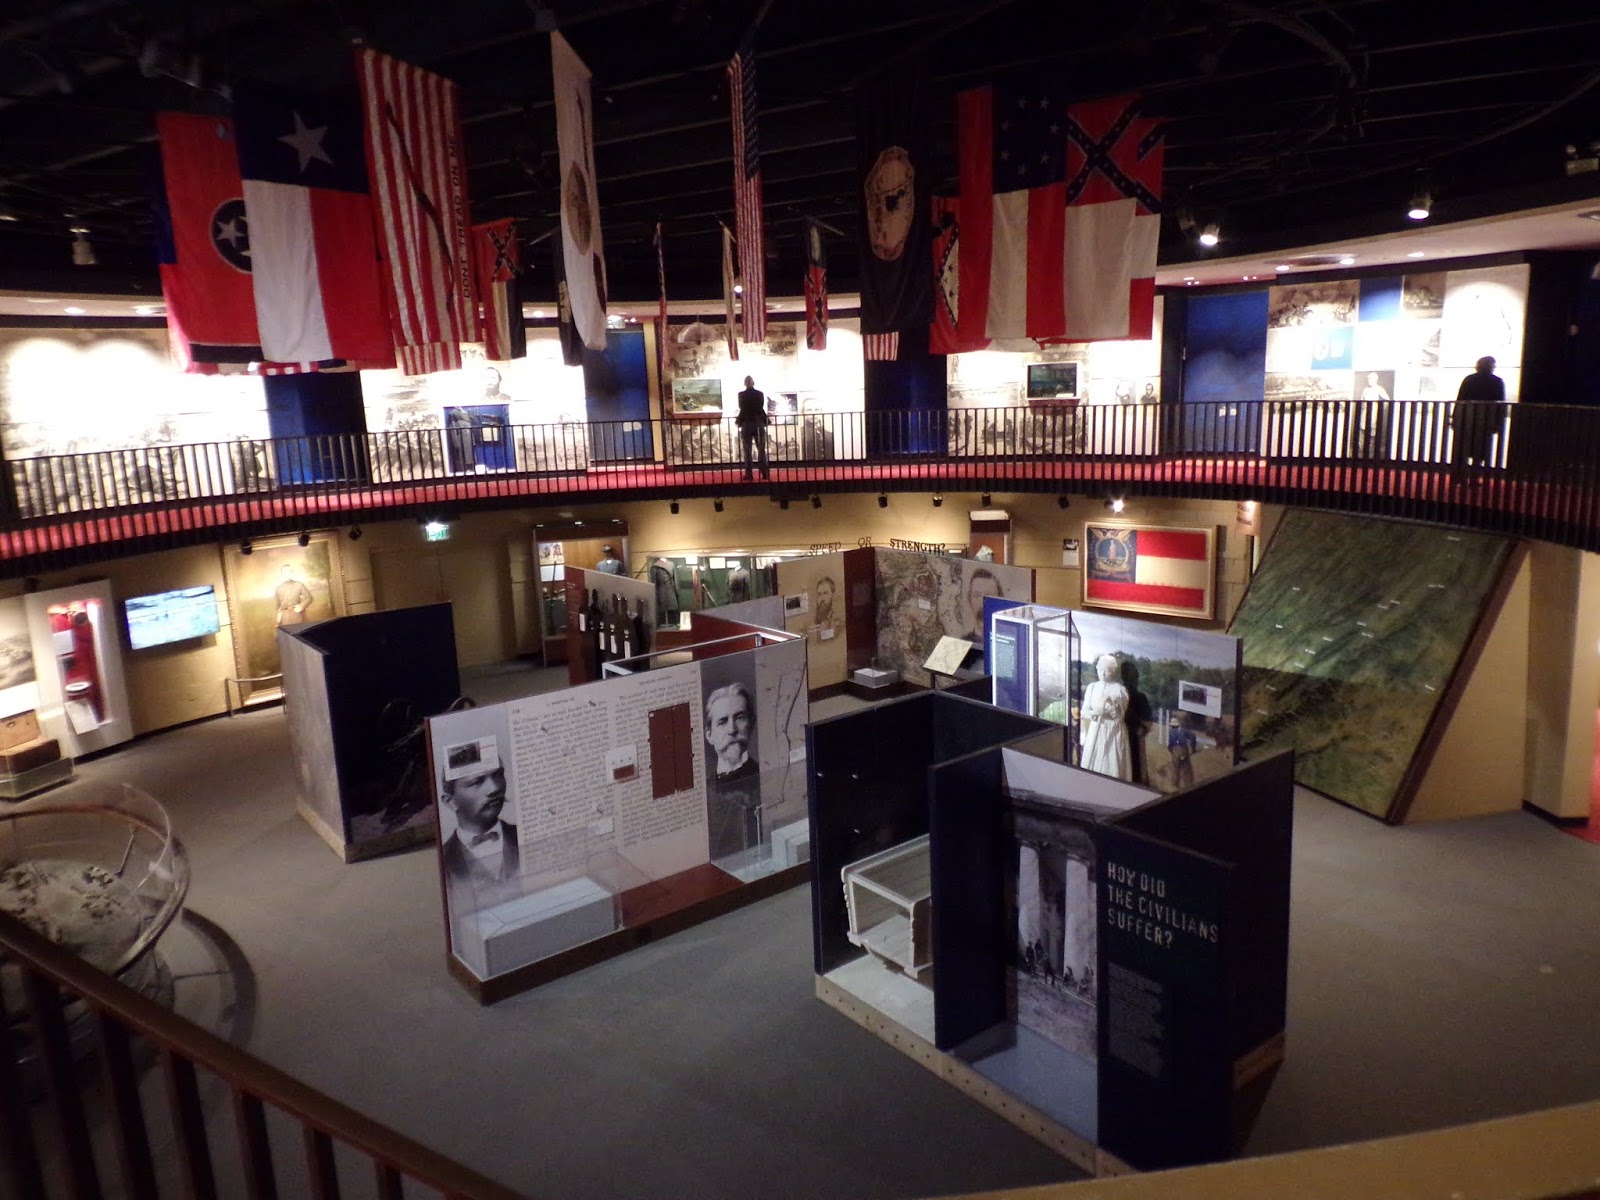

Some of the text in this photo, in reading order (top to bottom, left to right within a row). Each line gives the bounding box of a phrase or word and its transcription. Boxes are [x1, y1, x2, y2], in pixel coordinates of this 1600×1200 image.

[451, 166, 460, 187] ON
[858, 536, 872, 549] OR
[889, 538, 946, 556] STRENGTH?
[1140, 873, 1166, 898] DID
[1107, 884, 1219, 943] THE CIVILIANS
[1107, 908, 1173, 949] SUFFER?
